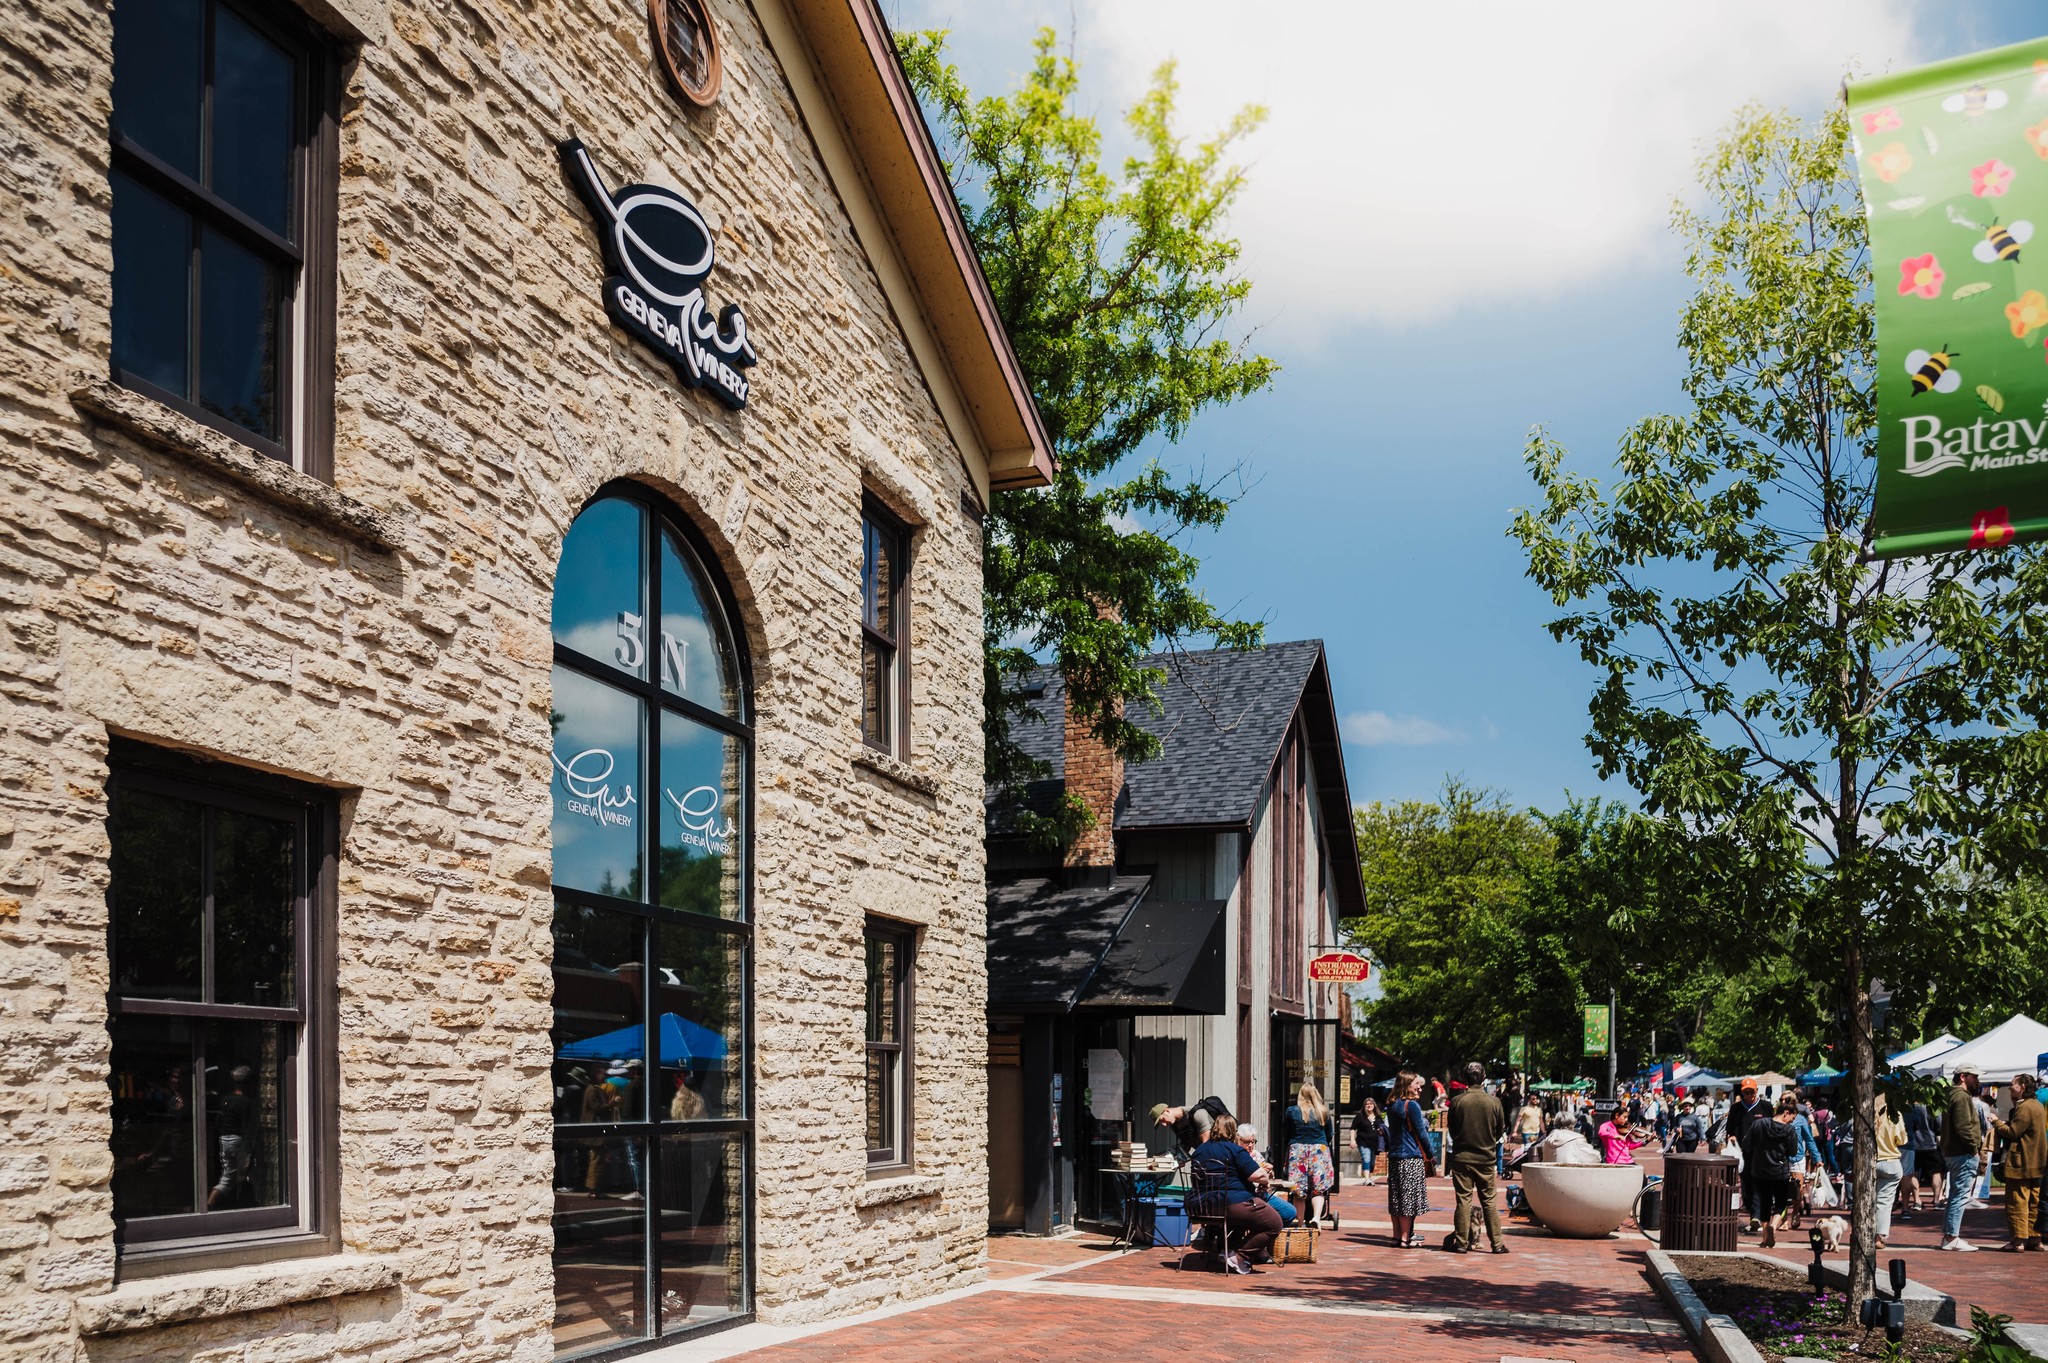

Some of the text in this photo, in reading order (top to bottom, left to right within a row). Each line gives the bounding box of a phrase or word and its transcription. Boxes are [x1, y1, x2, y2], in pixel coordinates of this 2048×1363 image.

[617, 285, 749, 401] GENEVA WINERY
[1898, 415, 2048, 470] Batav
[621, 610, 690, 691] 5 N
[567, 800, 632, 827] GENEVA WINERY
[681, 832, 733, 855] GENEVA WINERY
[1313, 961, 1366, 970] INSTRUMENT
[1317, 968, 1362, 976] EXCHANGE
[1285, 1060, 1332, 1068] INSTRUMENT
[1288, 1069, 1329, 1078] EXCHANGE
